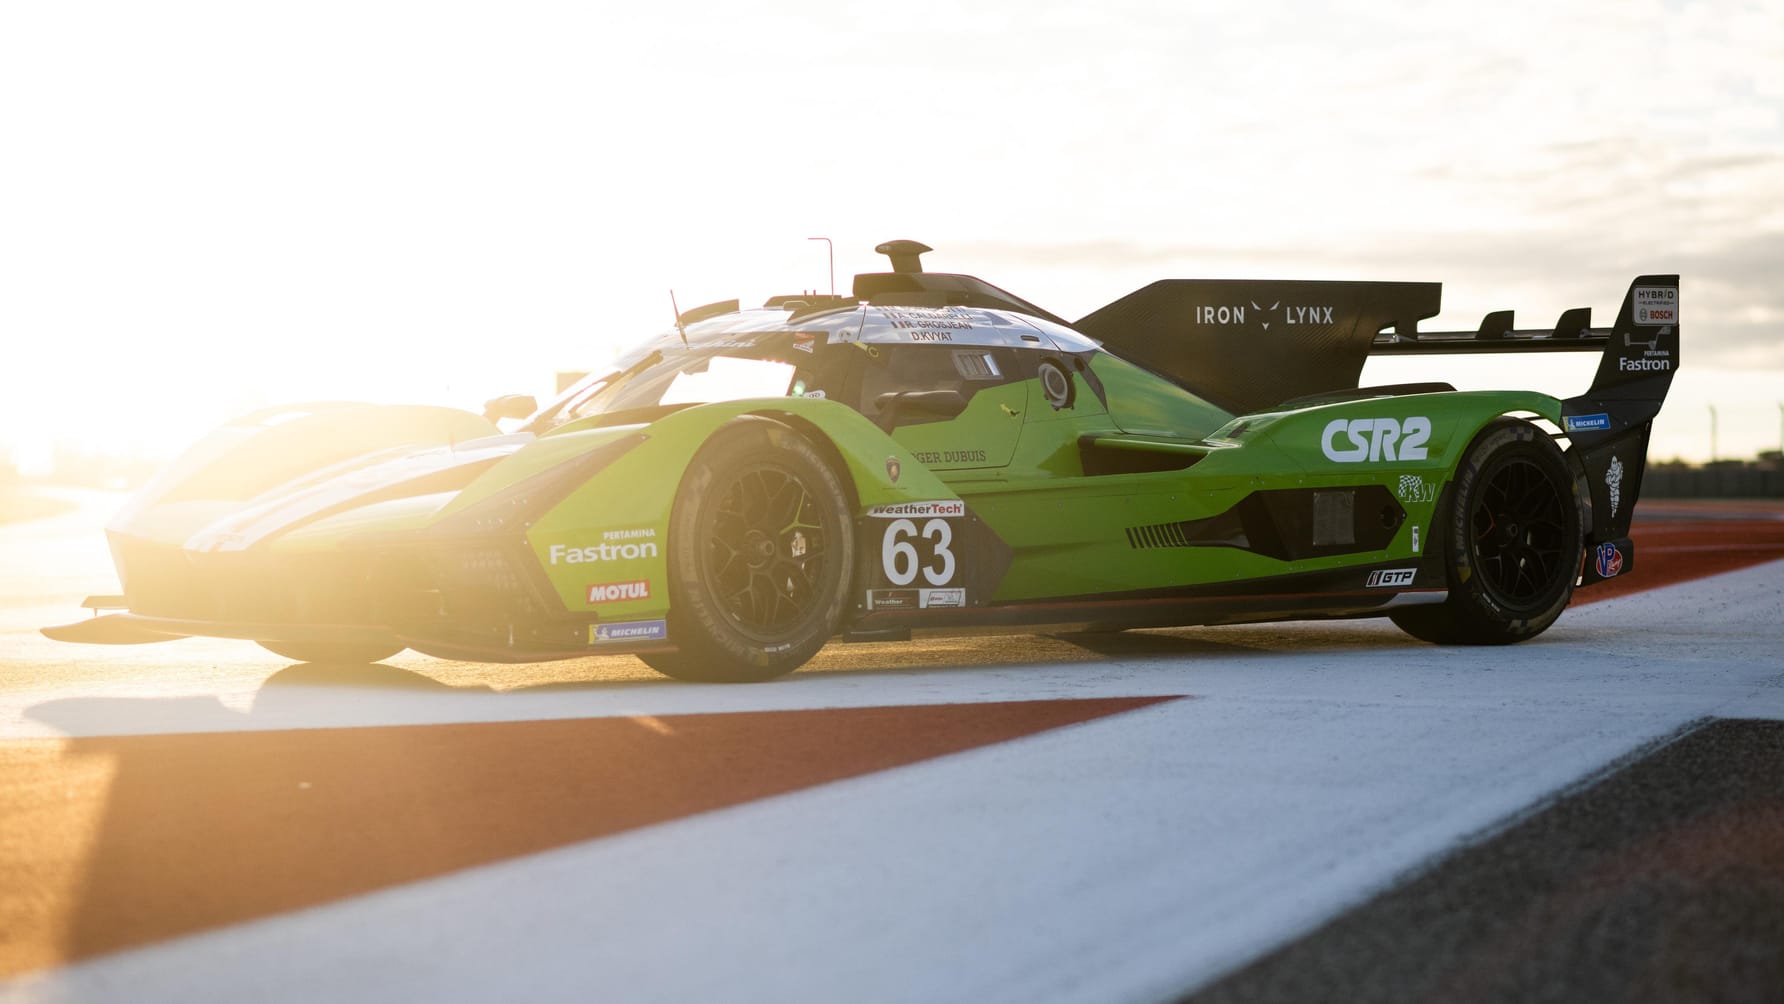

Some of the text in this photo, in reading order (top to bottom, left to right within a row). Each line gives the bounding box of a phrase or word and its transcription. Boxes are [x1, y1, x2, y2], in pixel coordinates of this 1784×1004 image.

[1638, 289, 1674, 299] HYBRID
[1196, 306, 1334, 324] IRON LYNX
[1649, 310, 1673, 320] BOSCH
[918, 321, 973, 330] GROSJEAN
[911, 331, 953, 341] D.KVYAT
[1619, 357, 1670, 371] Fastron
[1575, 419, 1605, 427] MICHELIN
[1321, 416, 1432, 462] CSR2
[943, 450, 986, 463] DUBUIS
[873, 503, 961, 514] WeatherTech
[603, 528, 656, 540] PERTAMINA
[549, 542, 658, 565] Fastron
[882, 518, 956, 586] 63
[1382, 571, 1413, 584] GTP
[589, 582, 649, 602] MOTUL
[611, 626, 660, 637] MICHELIN
